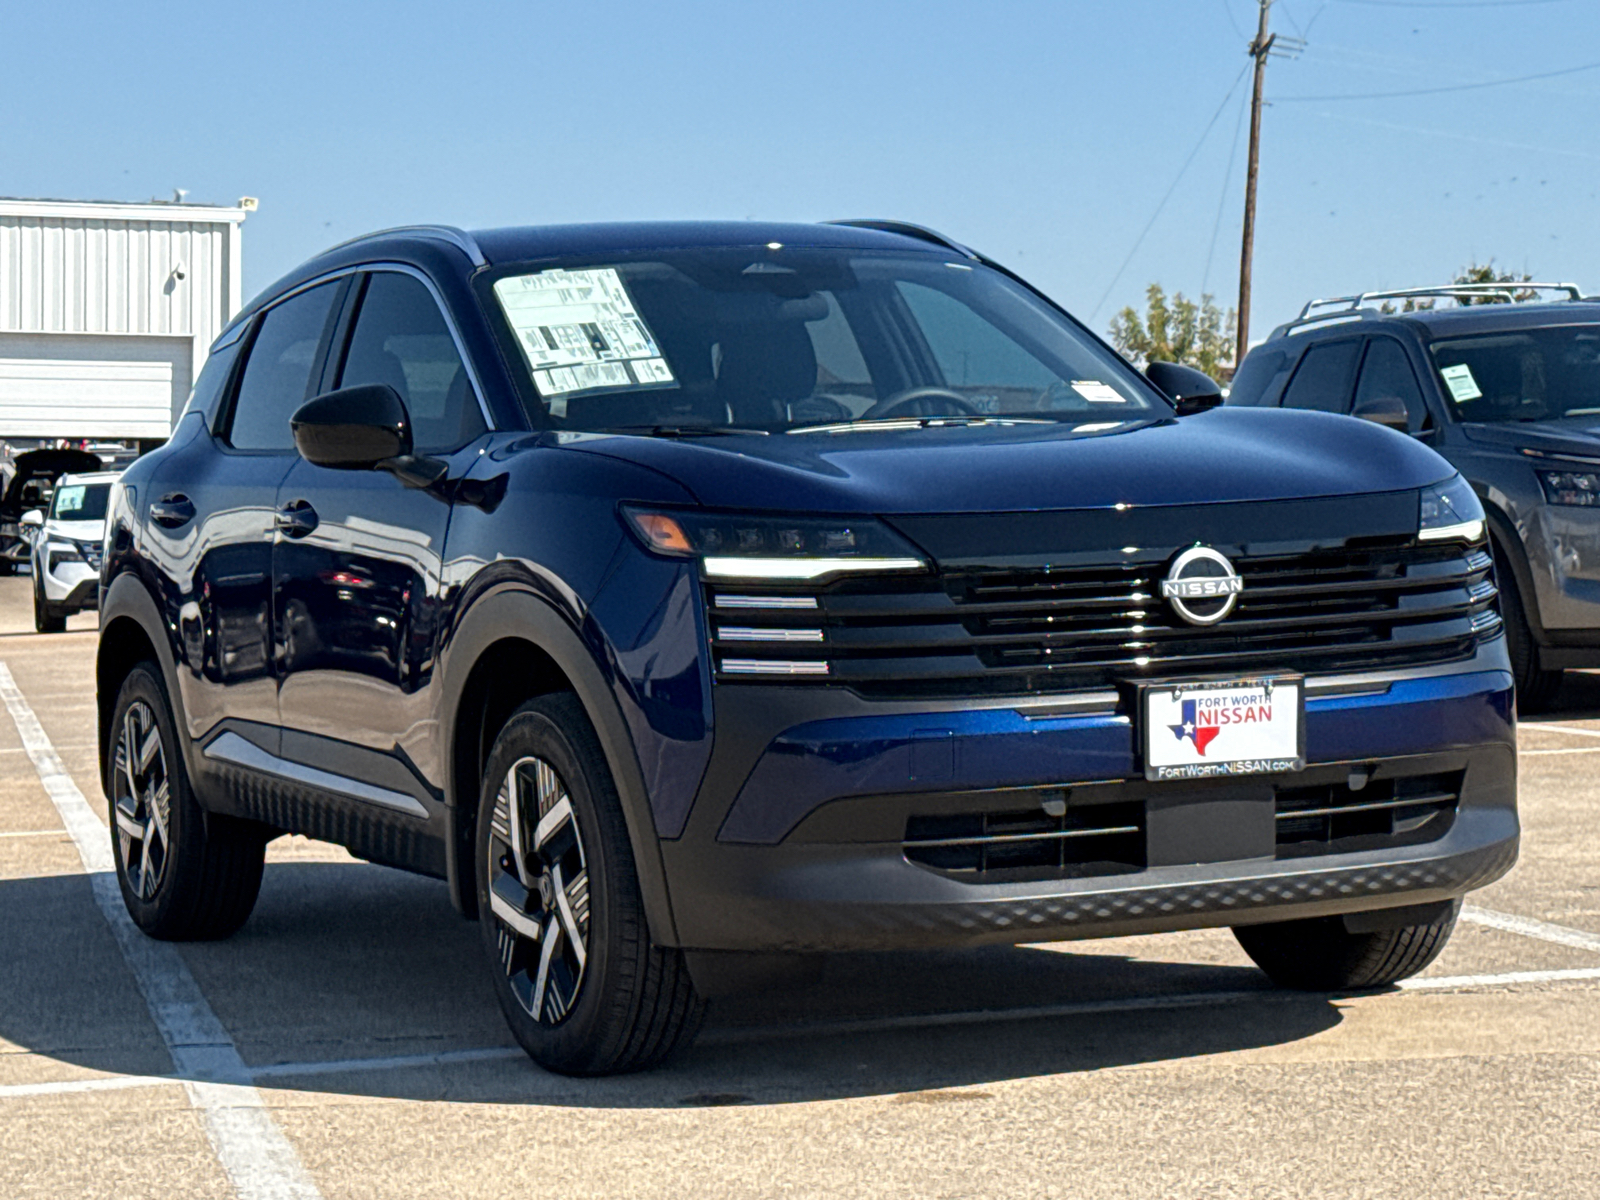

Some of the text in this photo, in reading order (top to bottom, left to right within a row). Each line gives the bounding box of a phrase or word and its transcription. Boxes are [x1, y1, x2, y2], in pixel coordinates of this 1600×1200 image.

[1164, 579, 1241, 596] NISSAN
[1198, 695, 1272, 708] FORT WORTH
[1198, 705, 1272, 725] NISSAN
